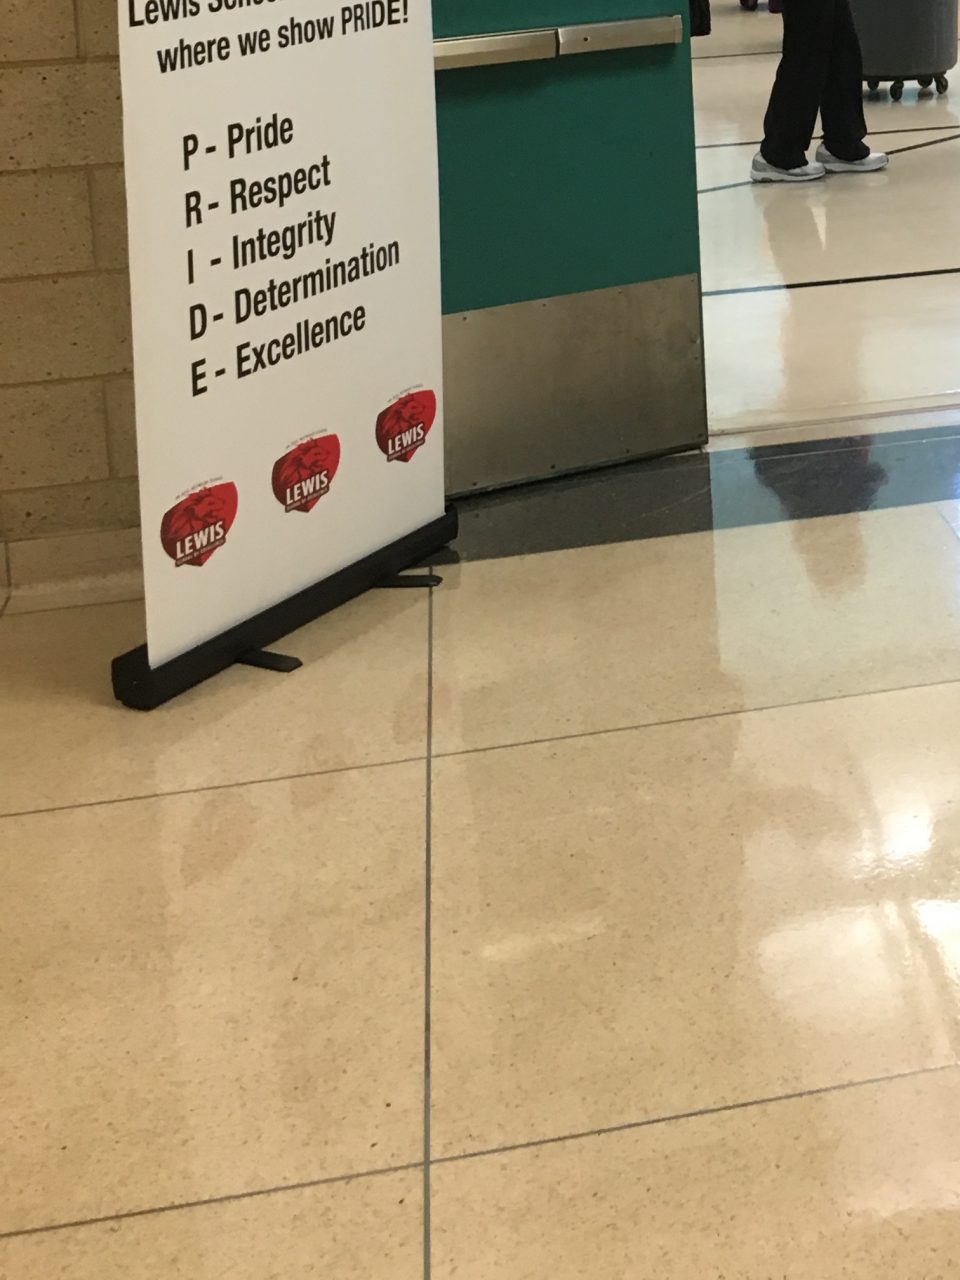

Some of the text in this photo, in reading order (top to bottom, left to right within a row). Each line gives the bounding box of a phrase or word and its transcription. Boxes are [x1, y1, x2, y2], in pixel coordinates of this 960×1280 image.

[156, 35, 230, 74] where
[237, 27, 271, 54] we
[277, 12, 335, 49] show
[227, 113, 294, 160] Pride
[230, 154, 332, 215] Respect
[232, 209, 337, 270] Integrity
[234, 239, 400, 325] Determination
[236, 305, 367, 379] Excellence
[387, 423, 425, 455] LEWIS
[286, 470, 329, 505] LEWIS
[176, 521, 225, 559] LEWIS
